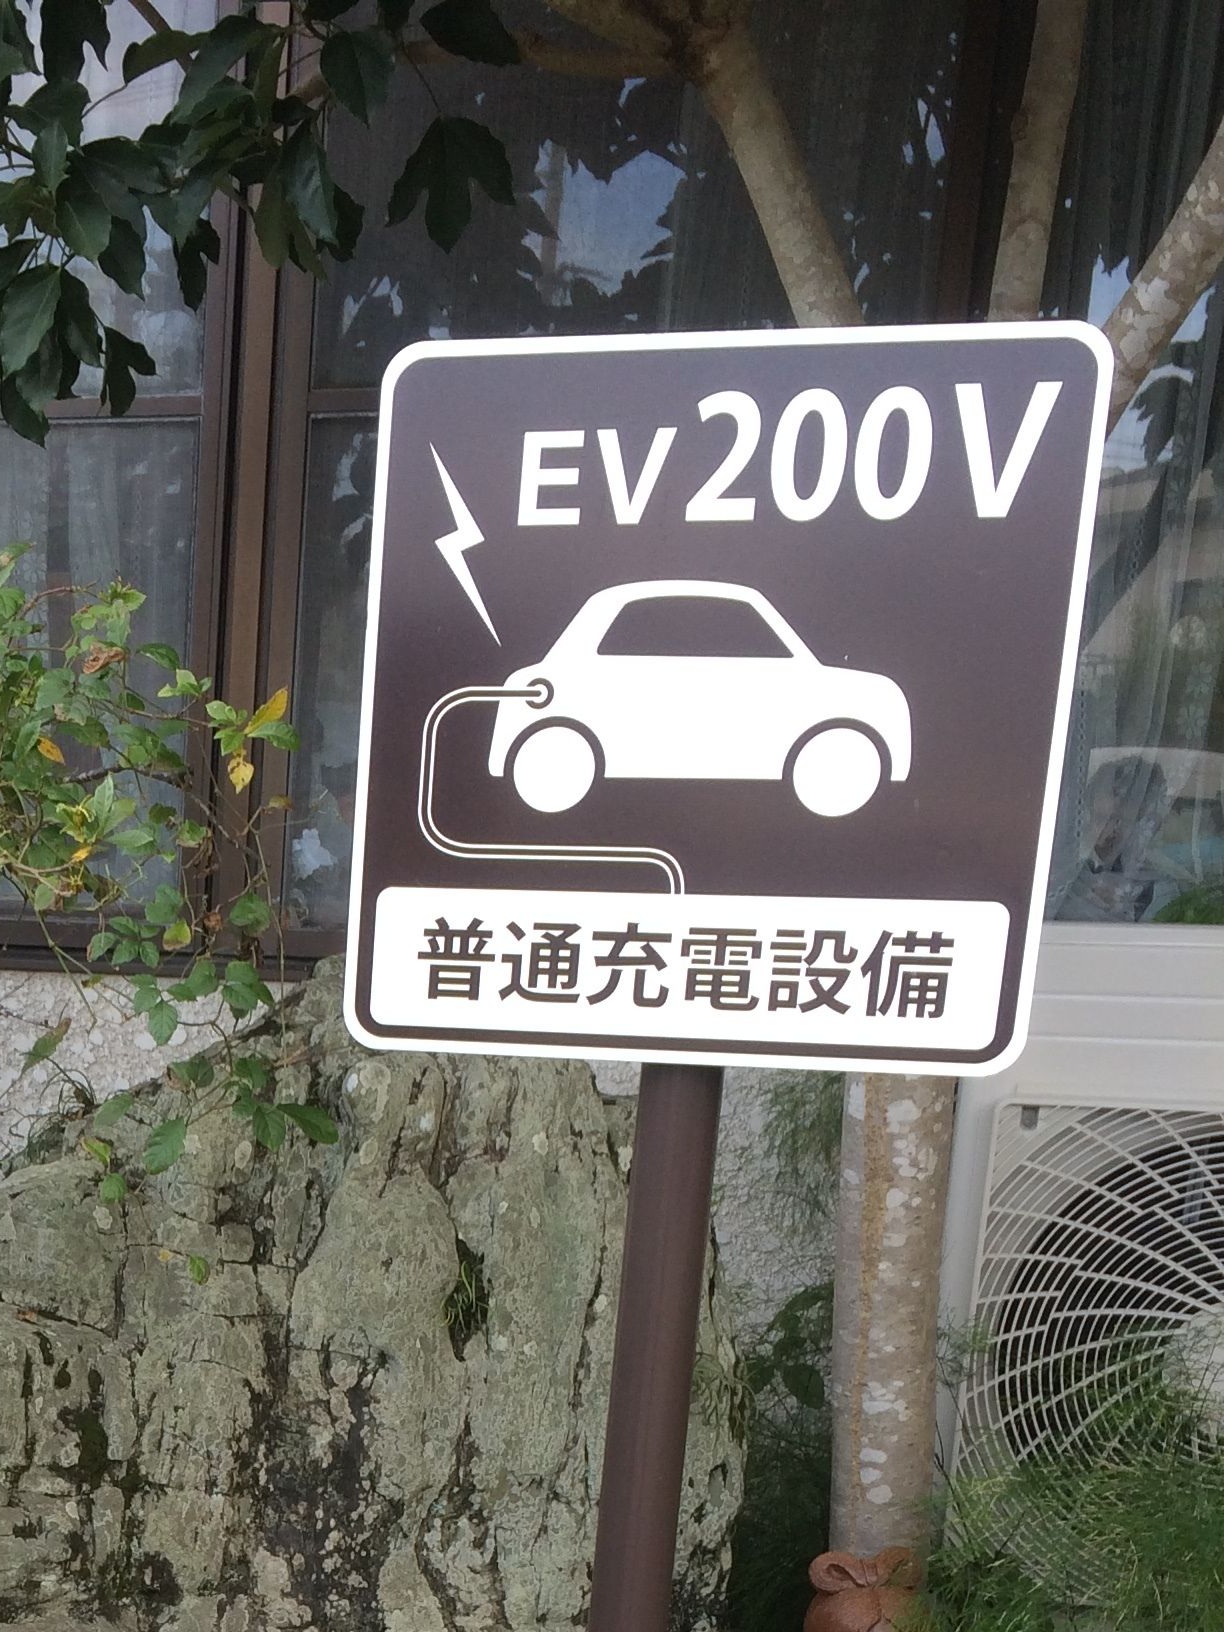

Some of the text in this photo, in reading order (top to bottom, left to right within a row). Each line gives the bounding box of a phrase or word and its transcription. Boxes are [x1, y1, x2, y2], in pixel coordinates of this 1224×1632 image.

[418, 917, 956, 1020] 普通充電設備
